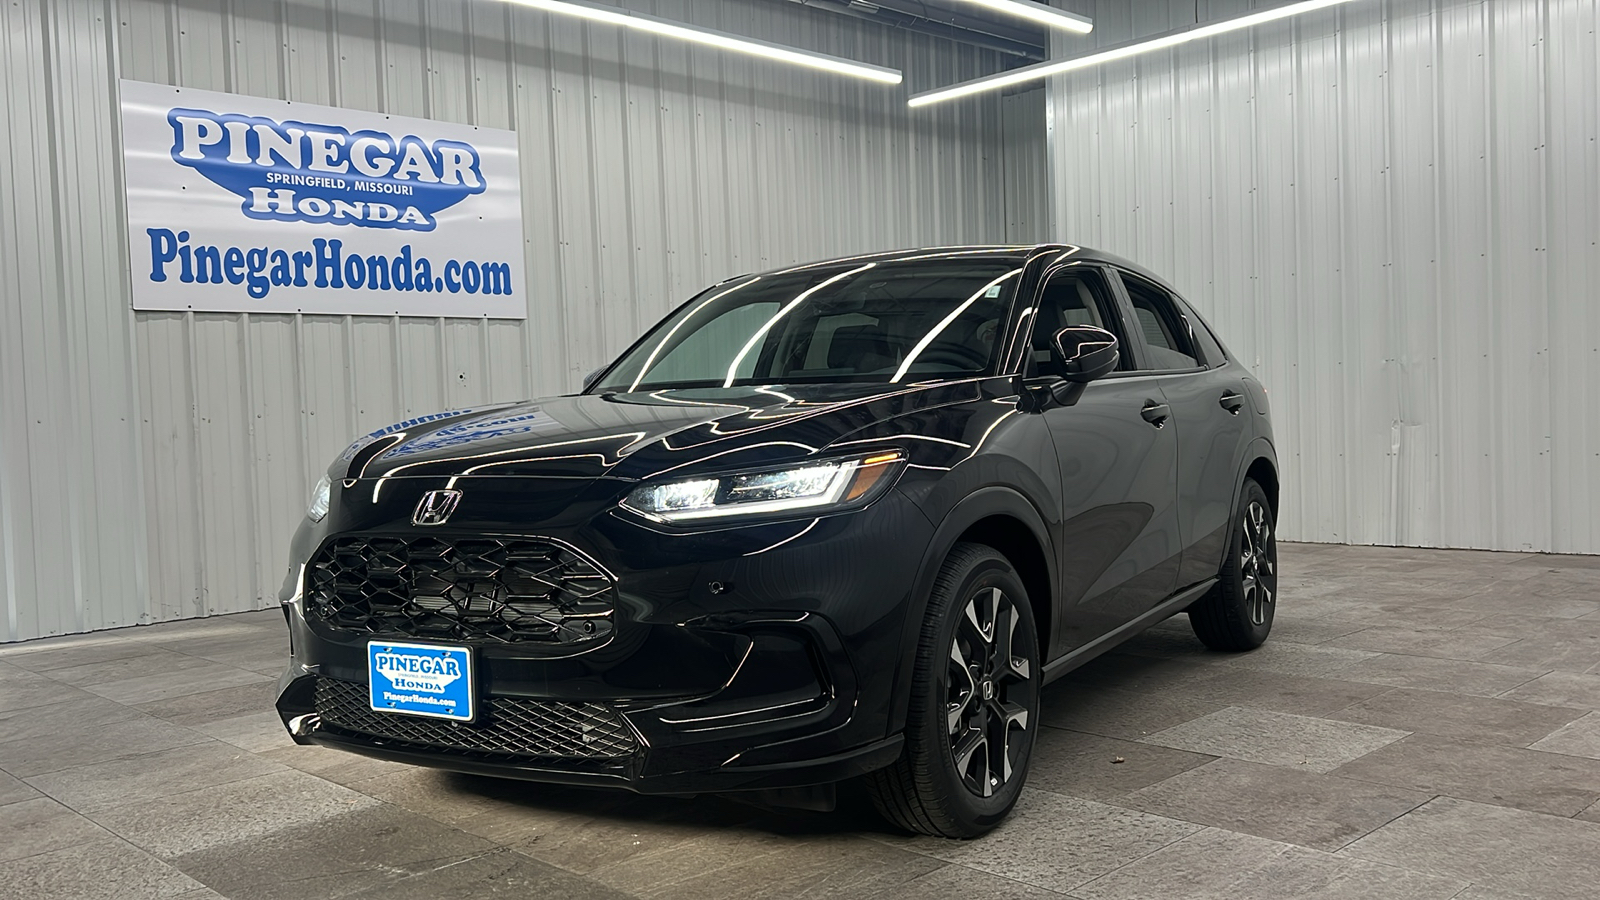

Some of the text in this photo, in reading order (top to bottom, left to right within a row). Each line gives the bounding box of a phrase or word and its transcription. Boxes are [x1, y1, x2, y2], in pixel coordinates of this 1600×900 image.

[175, 116, 481, 188] PINEGAR
[354, 180, 414, 196] MISSOURI
[249, 187, 431, 225] HONDA
[146, 228, 513, 299] PinegarHonda.com
[377, 655, 459, 676] PINEGAR
[394, 678, 442, 691] HONDA
[383, 691, 457, 707] PinegarHonda.com
